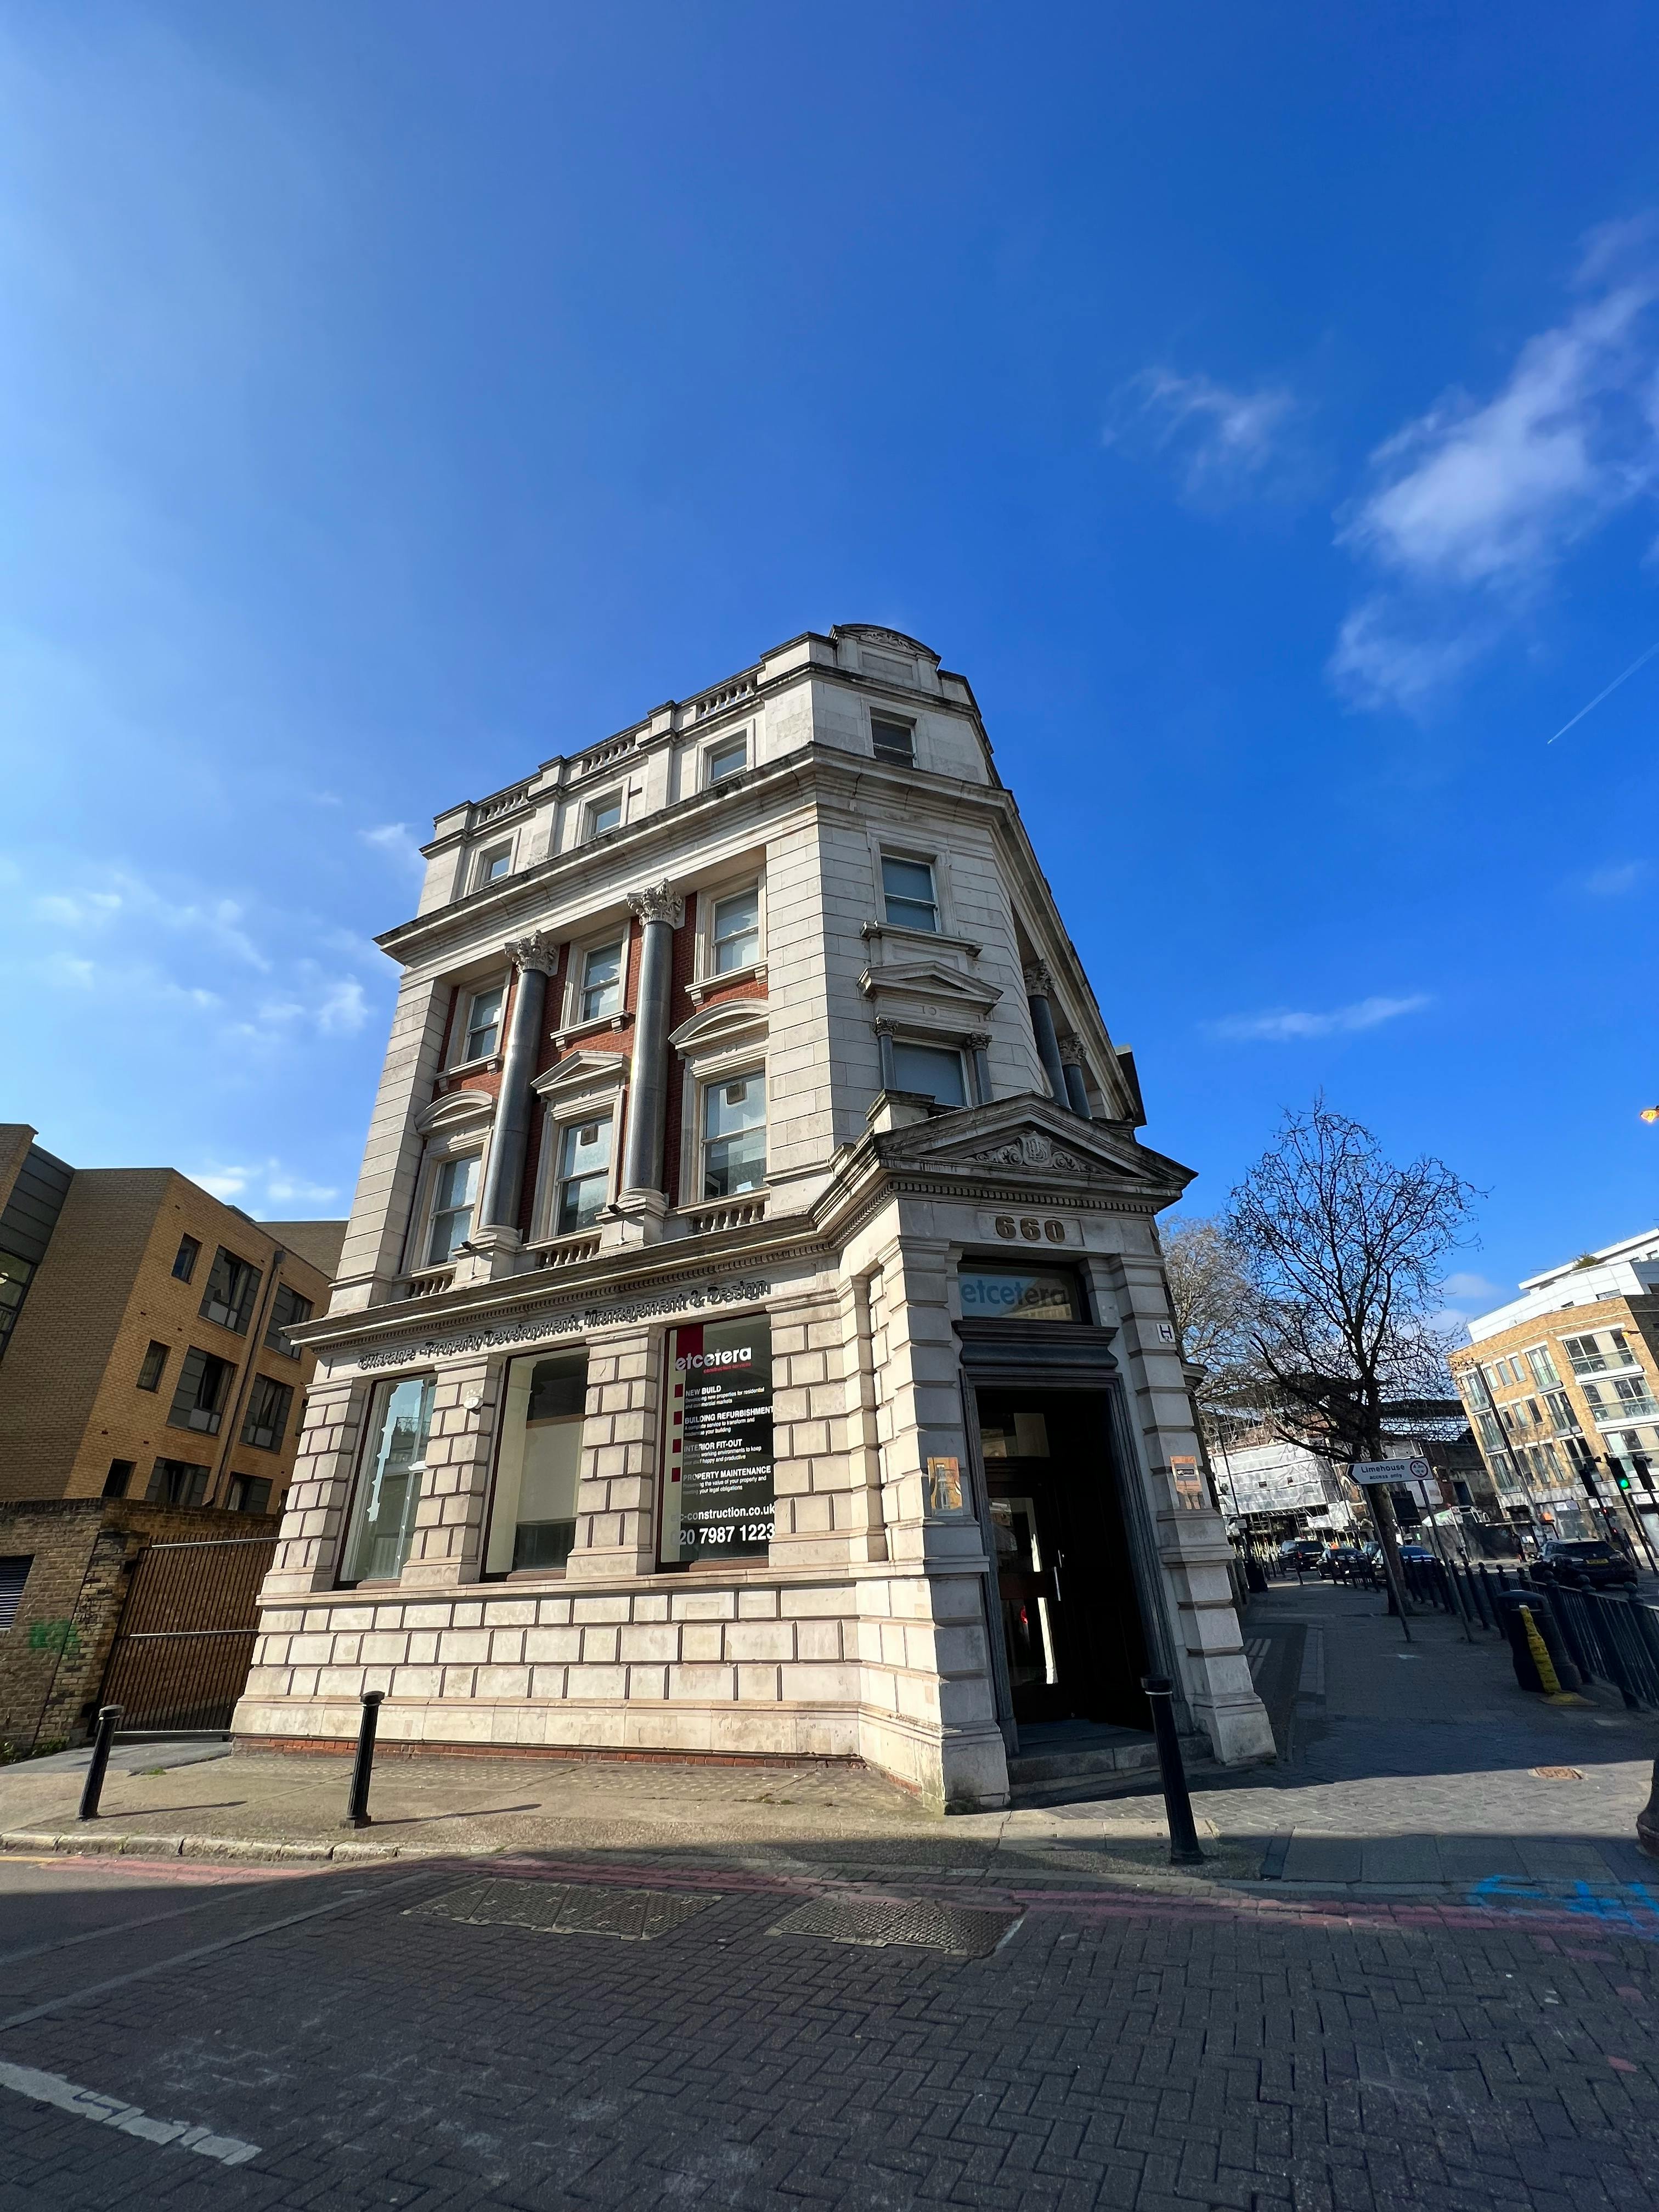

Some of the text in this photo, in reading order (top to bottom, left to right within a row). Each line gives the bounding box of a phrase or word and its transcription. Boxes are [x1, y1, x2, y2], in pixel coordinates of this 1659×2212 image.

[995, 1215, 1065, 1243] 660
[961, 1279, 1065, 1306] etcetera
[425, 1335, 482, 1358] Property
[583, 1292, 688, 1328] Management
[689, 1290, 705, 1308] &
[707, 1279, 771, 1306] Design
[1159, 1324, 1172, 1339] H
[675, 1347, 752, 1370] etcetera
[686, 1385, 721, 1397] NEW BUILD
[685, 1406, 774, 1424] BUILDING REFURBISHMENT
[684, 1438, 742, 1452] INTERIOR FIT-OUT
[683, 1465, 771, 1481] PROPERTY MAINTENANCE
[1361, 1464, 1405, 1473] Limehouse
[672, 1503, 775, 1521] c-construction.co.uk
[671, 1522, 776, 1545] 20 7987 1223
